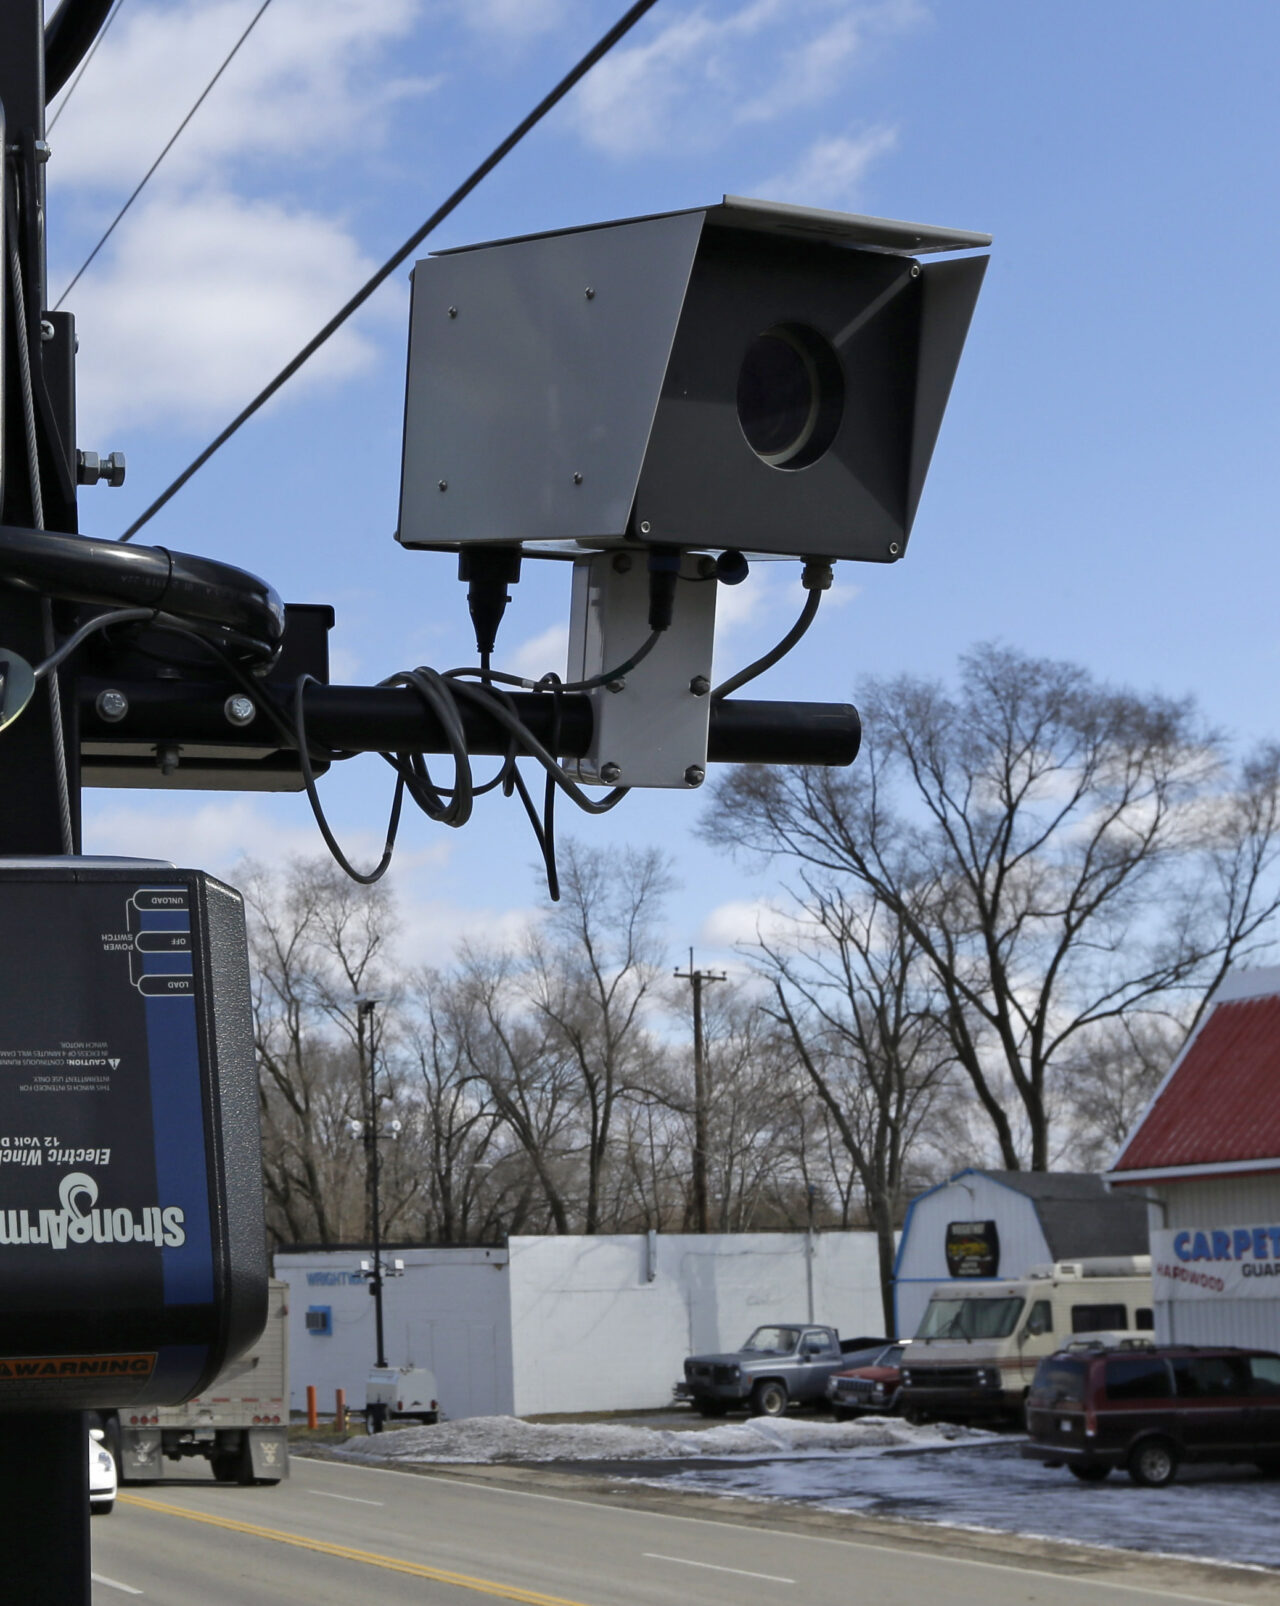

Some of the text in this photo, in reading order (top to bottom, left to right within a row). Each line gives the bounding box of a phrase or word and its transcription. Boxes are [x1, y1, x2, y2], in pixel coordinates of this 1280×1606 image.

[15, 1137, 40, 1146] Volt
[44, 1137, 59, 1146] 12
[47, 1148, 111, 1165] Electric
[1157, 1264, 1224, 1291] HARDWOOD
[14, 1359, 149, 1376] WARNING
